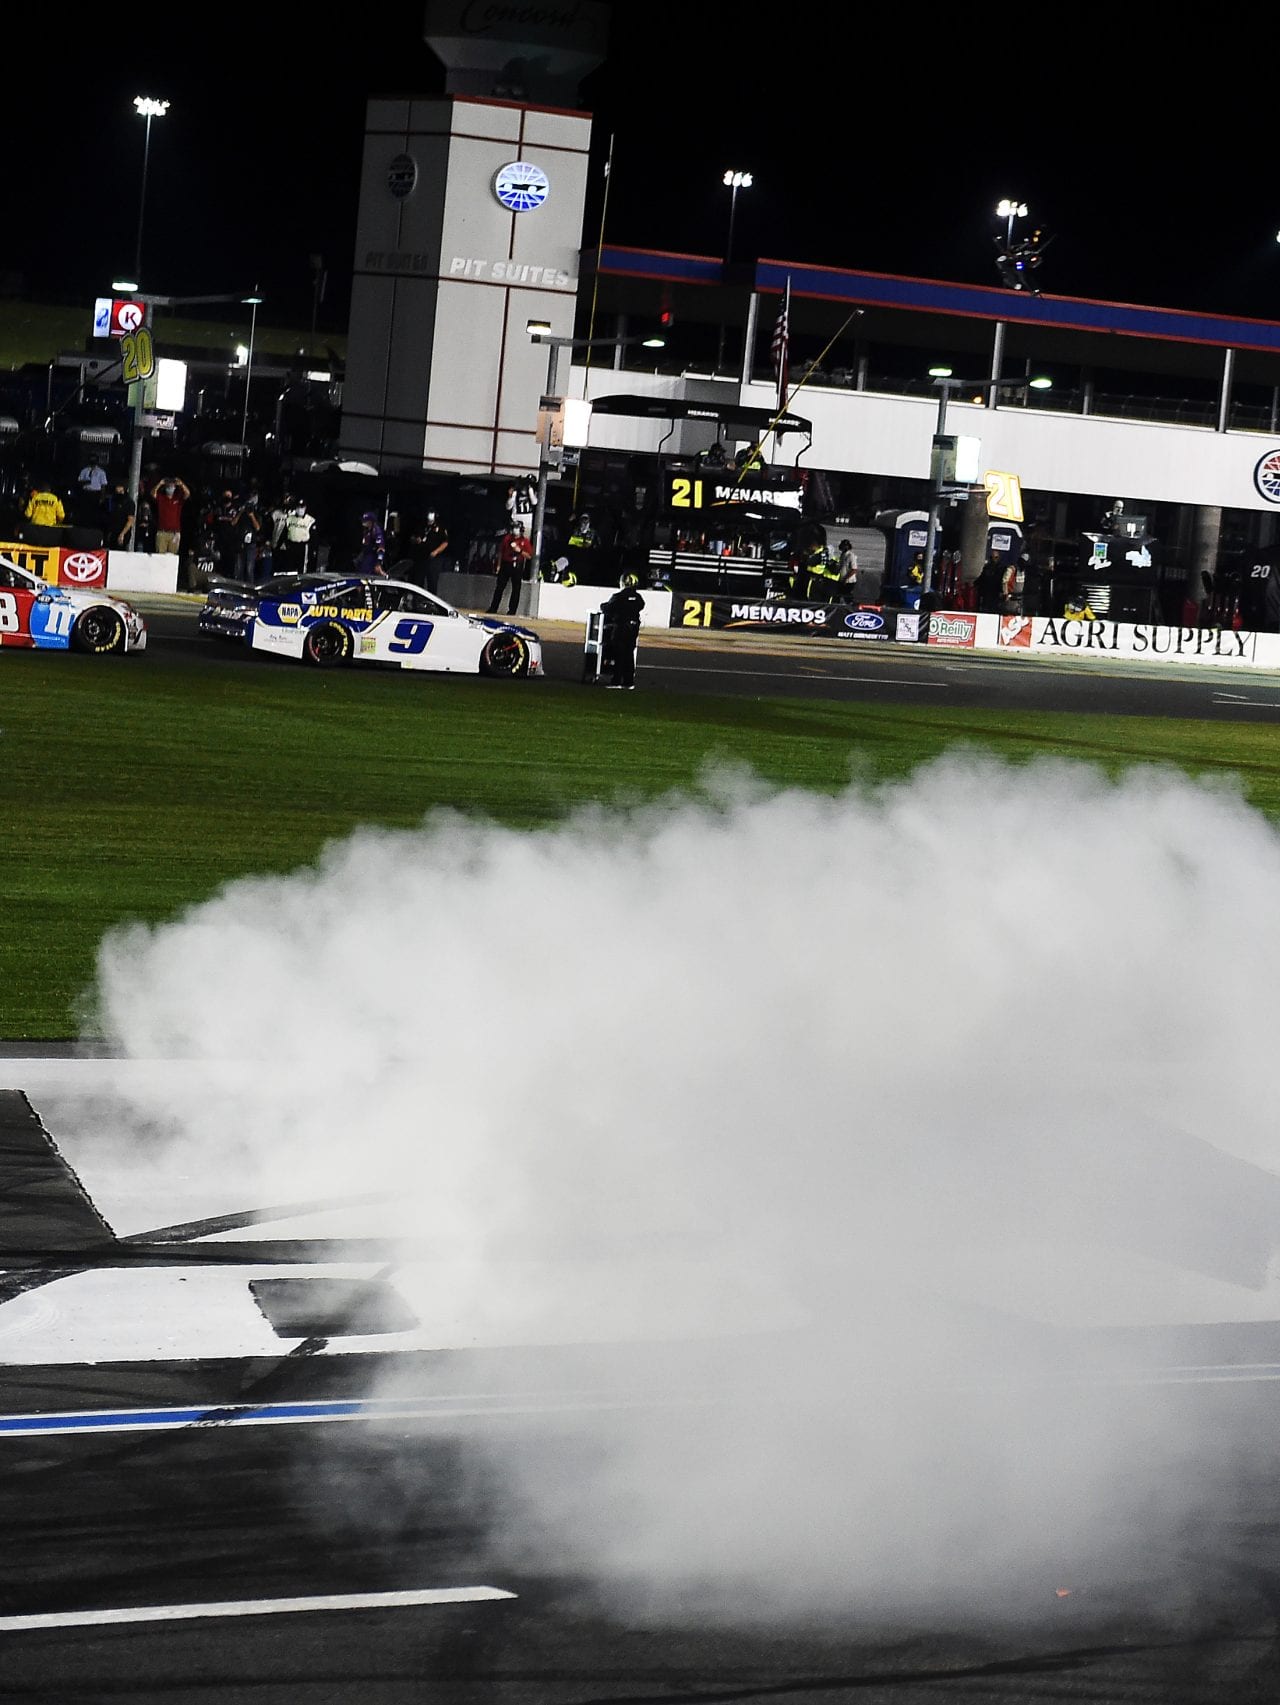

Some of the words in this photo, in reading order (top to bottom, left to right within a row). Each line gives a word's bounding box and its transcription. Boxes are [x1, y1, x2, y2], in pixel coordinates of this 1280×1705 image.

[450, 257, 487, 276] PIT
[492, 261, 569, 286] SUITES
[121, 327, 154, 383] 20
[688, 409, 720, 417] MENARDS
[671, 479, 703, 508] 21
[987, 471, 1024, 521] 21
[1251, 565, 1271, 578] 20
[281, 607, 298, 617] NAPA
[309, 605, 338, 618] AUTO
[341, 608, 373, 622] PARTS
[682, 600, 712, 627] 21
[731, 603, 827, 624] MENARDS
[929, 616, 972, 640] O'Reilly
[389, 619, 434, 654] 9
[1038, 619, 1122, 650] AGRI
[1133, 625, 1255, 657] SUPPLY
